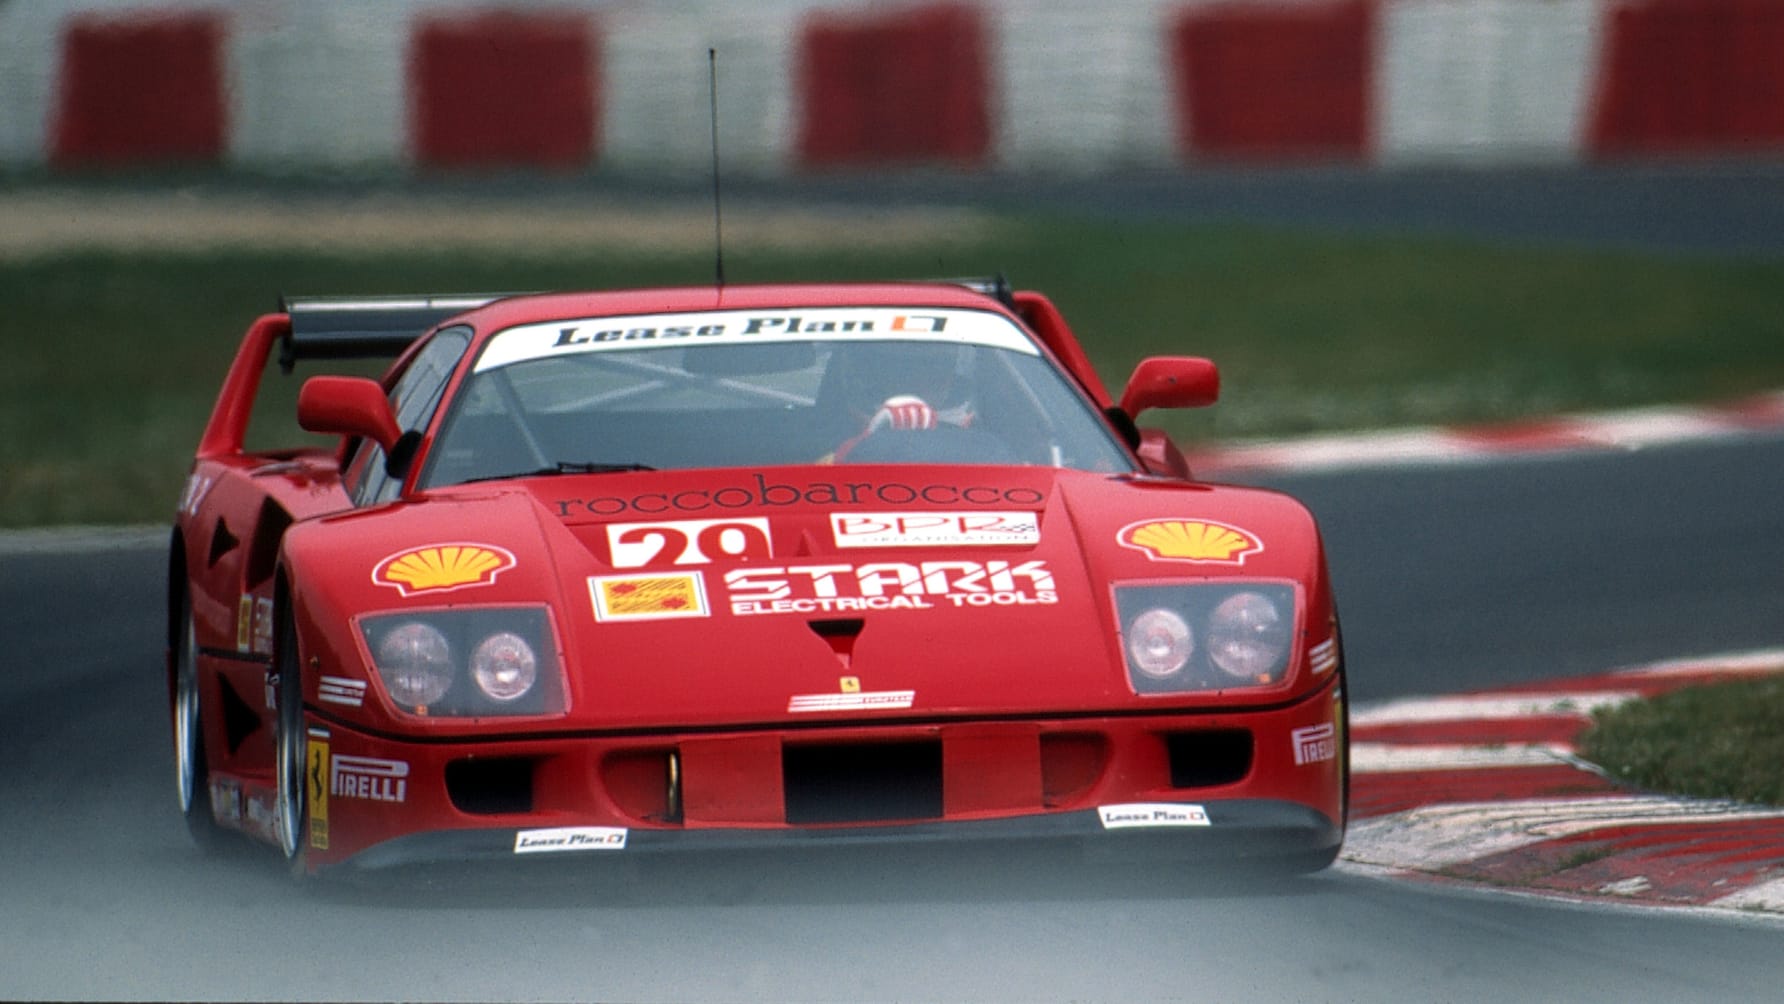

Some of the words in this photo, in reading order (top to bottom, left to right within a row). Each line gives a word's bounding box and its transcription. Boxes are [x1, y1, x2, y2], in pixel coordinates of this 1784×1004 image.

[552, 323, 726, 347] Lease
[742, 317, 876, 336] Plan
[556, 474, 1043, 516] roccobarocco
[837, 516, 1021, 535] BPR
[724, 560, 1056, 600] STARK
[731, 595, 934, 616] ELECTRICAL
[945, 590, 1058, 606] TOOLS
[331, 754, 409, 803] PIRELLI
[1105, 812, 1149, 822] Lease
[1154, 811, 1187, 820] Plan
[519, 838, 566, 848] Lease
[568, 834, 604, 845] Plan
